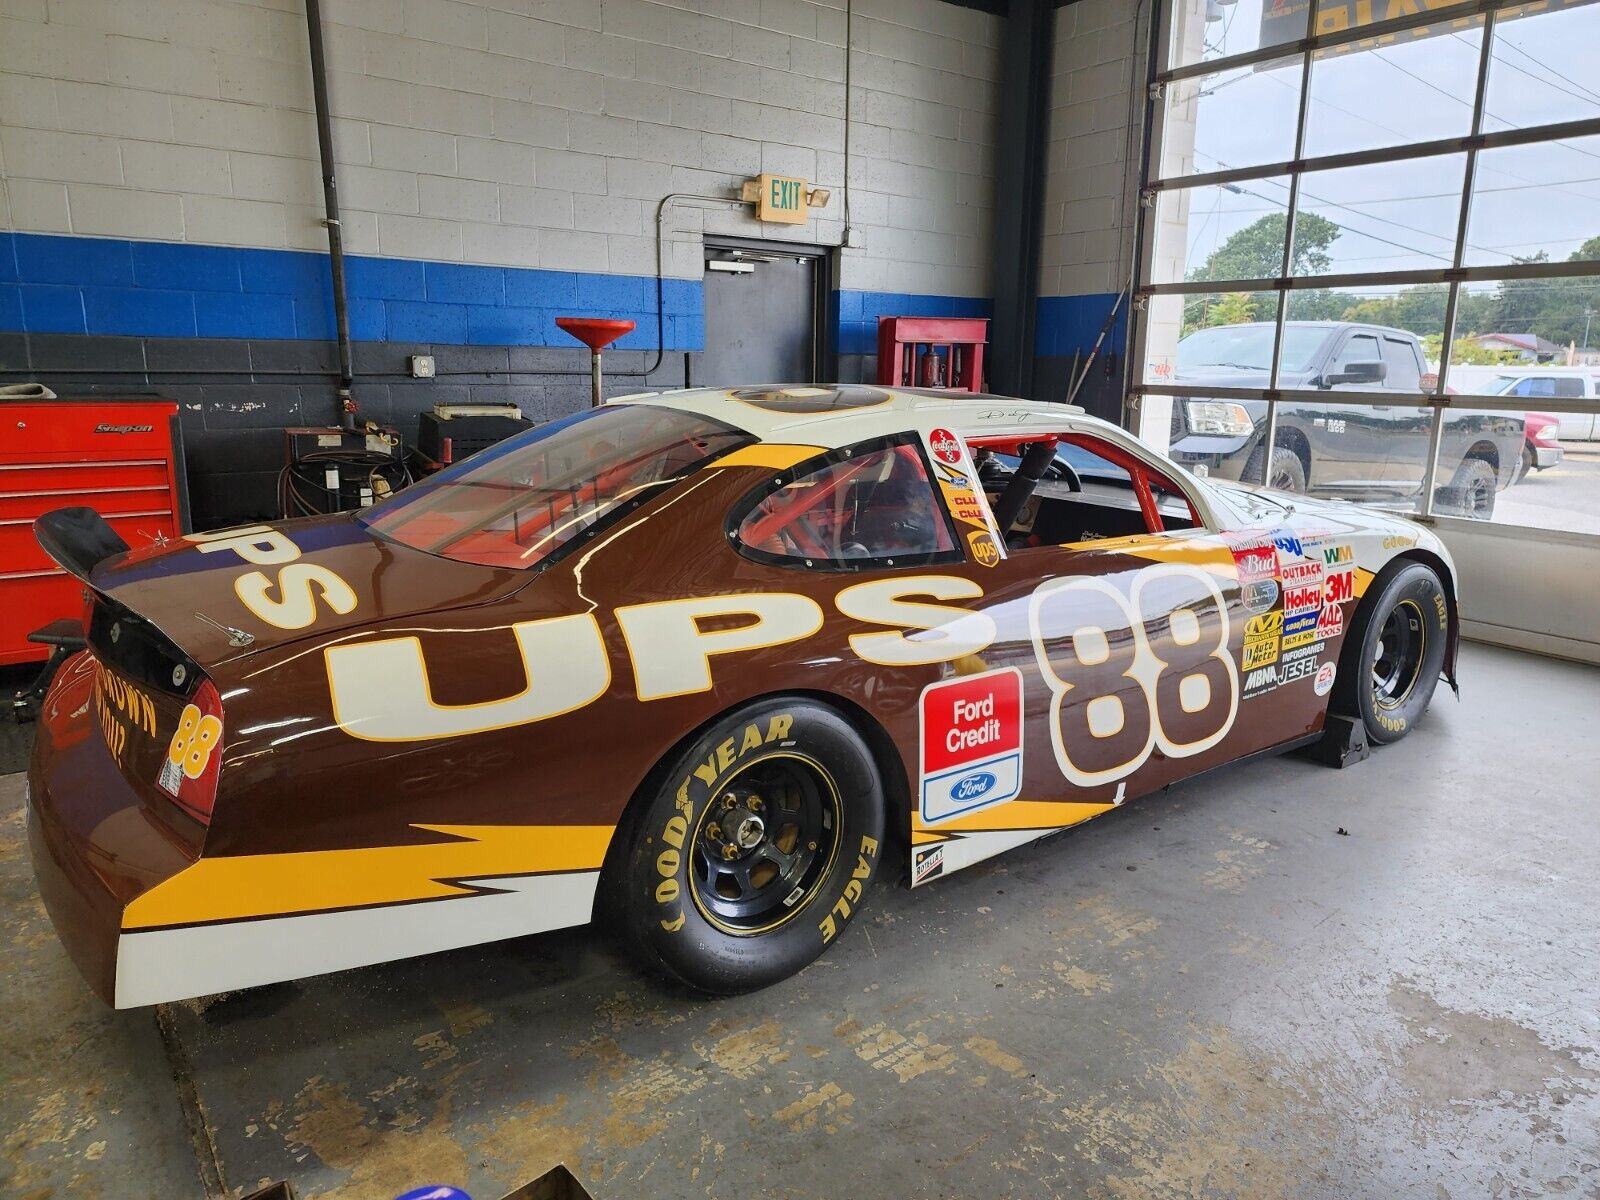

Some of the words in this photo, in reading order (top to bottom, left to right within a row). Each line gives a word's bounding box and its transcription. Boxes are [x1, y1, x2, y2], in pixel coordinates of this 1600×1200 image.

[771, 179, 801, 210] EXIT
[96, 424, 153, 434] Snap-on
[1247, 552, 1275, 574] Bud
[1282, 564, 1321, 579] OUTBACK
[1285, 588, 1320, 611] Holley
[1325, 572, 1353, 603] 3M
[1433, 593, 1447, 631] EAGLE
[1254, 641, 1273, 654] Auto
[1317, 627, 1341, 639] TOOLS
[324, 575, 997, 742] UPS
[1253, 651, 1276, 664] Meter
[1278, 656, 1318, 685] JESEL
[1028, 562, 1240, 788] 88
[1244, 666, 1277, 691] MBNA
[953, 693, 994, 725] Ford
[168, 703, 223, 780] 88
[946, 720, 1000, 753] Credit
[957, 774, 989, 800] Ford
[818, 835, 878, 944] EAGLE
